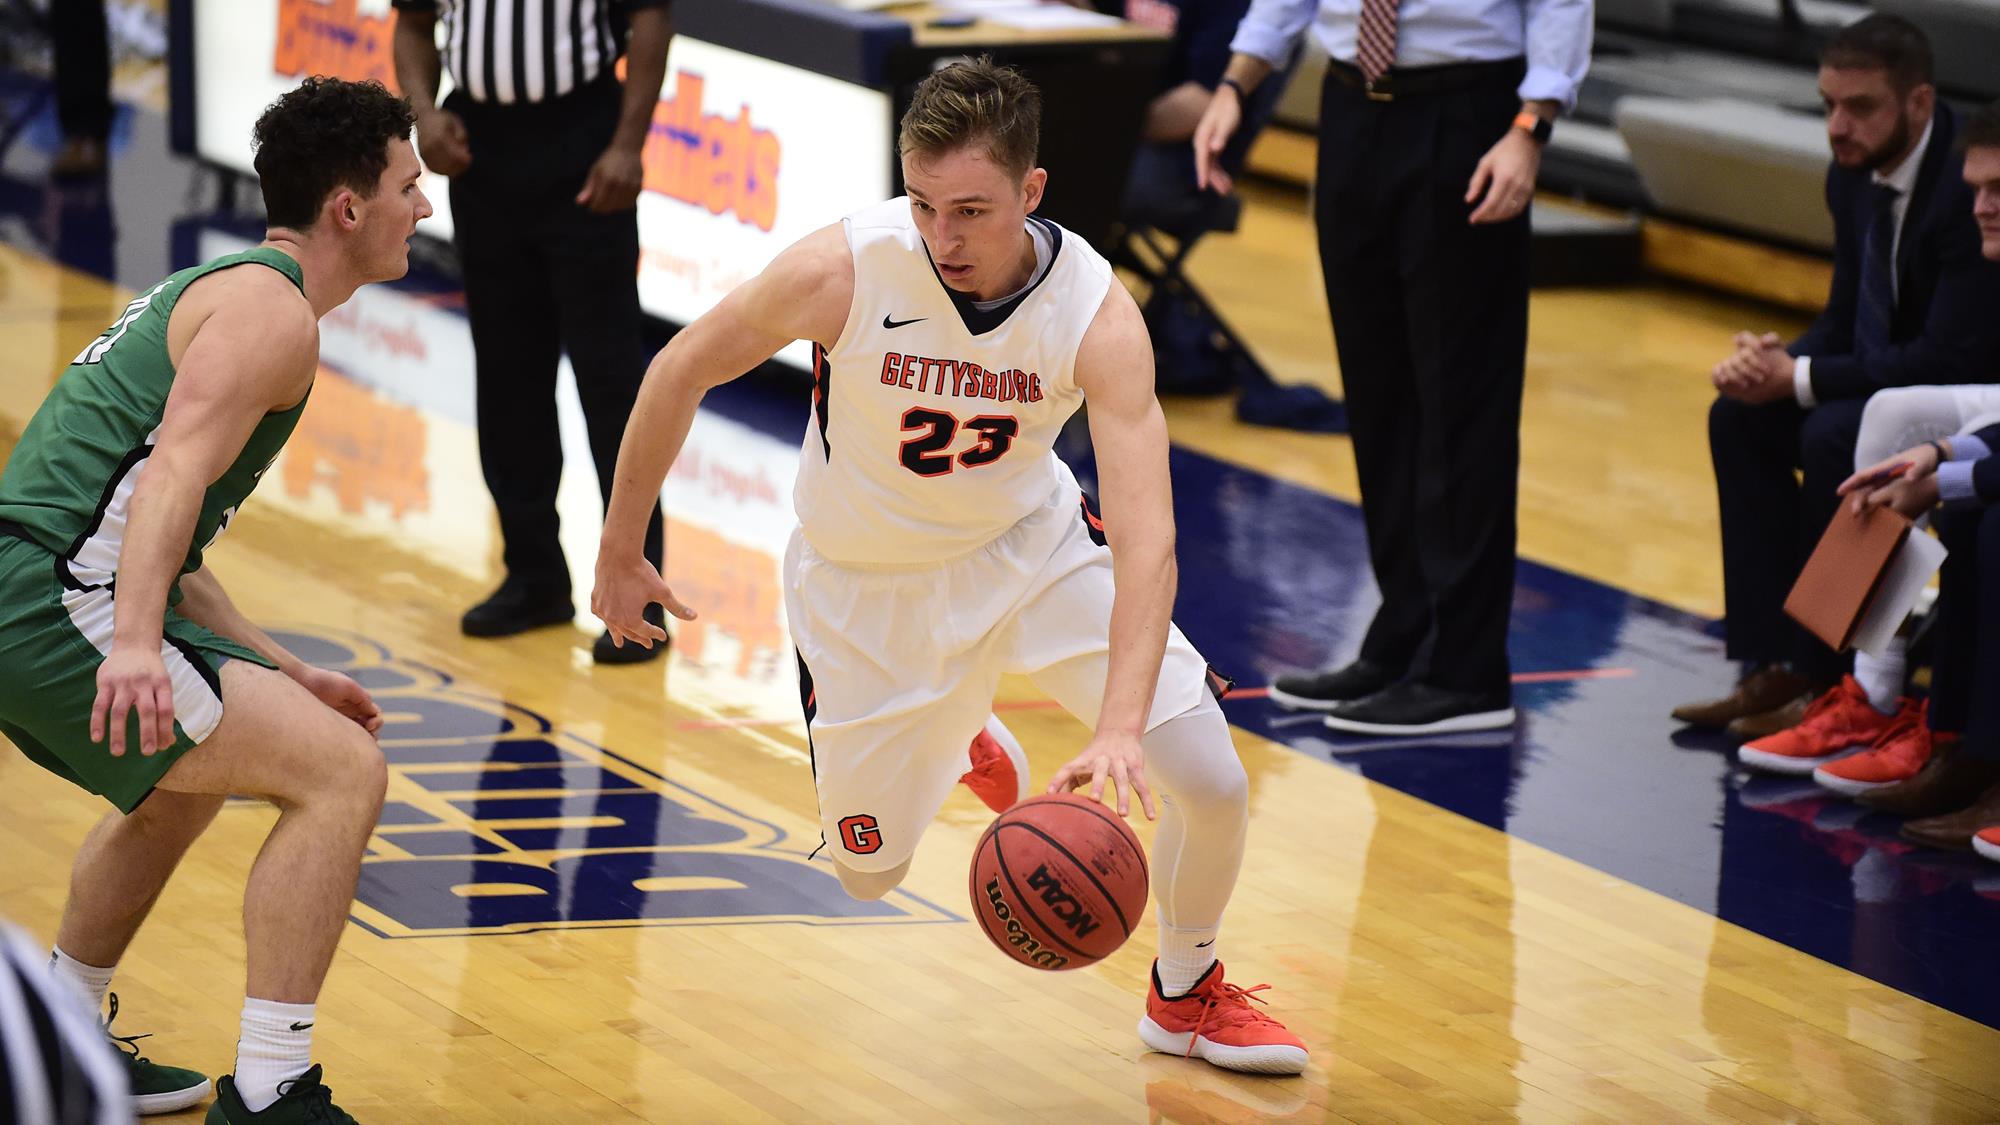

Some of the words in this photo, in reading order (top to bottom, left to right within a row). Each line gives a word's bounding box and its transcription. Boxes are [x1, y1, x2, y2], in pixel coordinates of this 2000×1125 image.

[880, 352, 1044, 404] GETTYSBURG
[898, 405, 1020, 478] 23
[837, 813, 884, 855] G
[985, 875, 1071, 970] Wilson
[1026, 863, 1100, 939] NCAA
